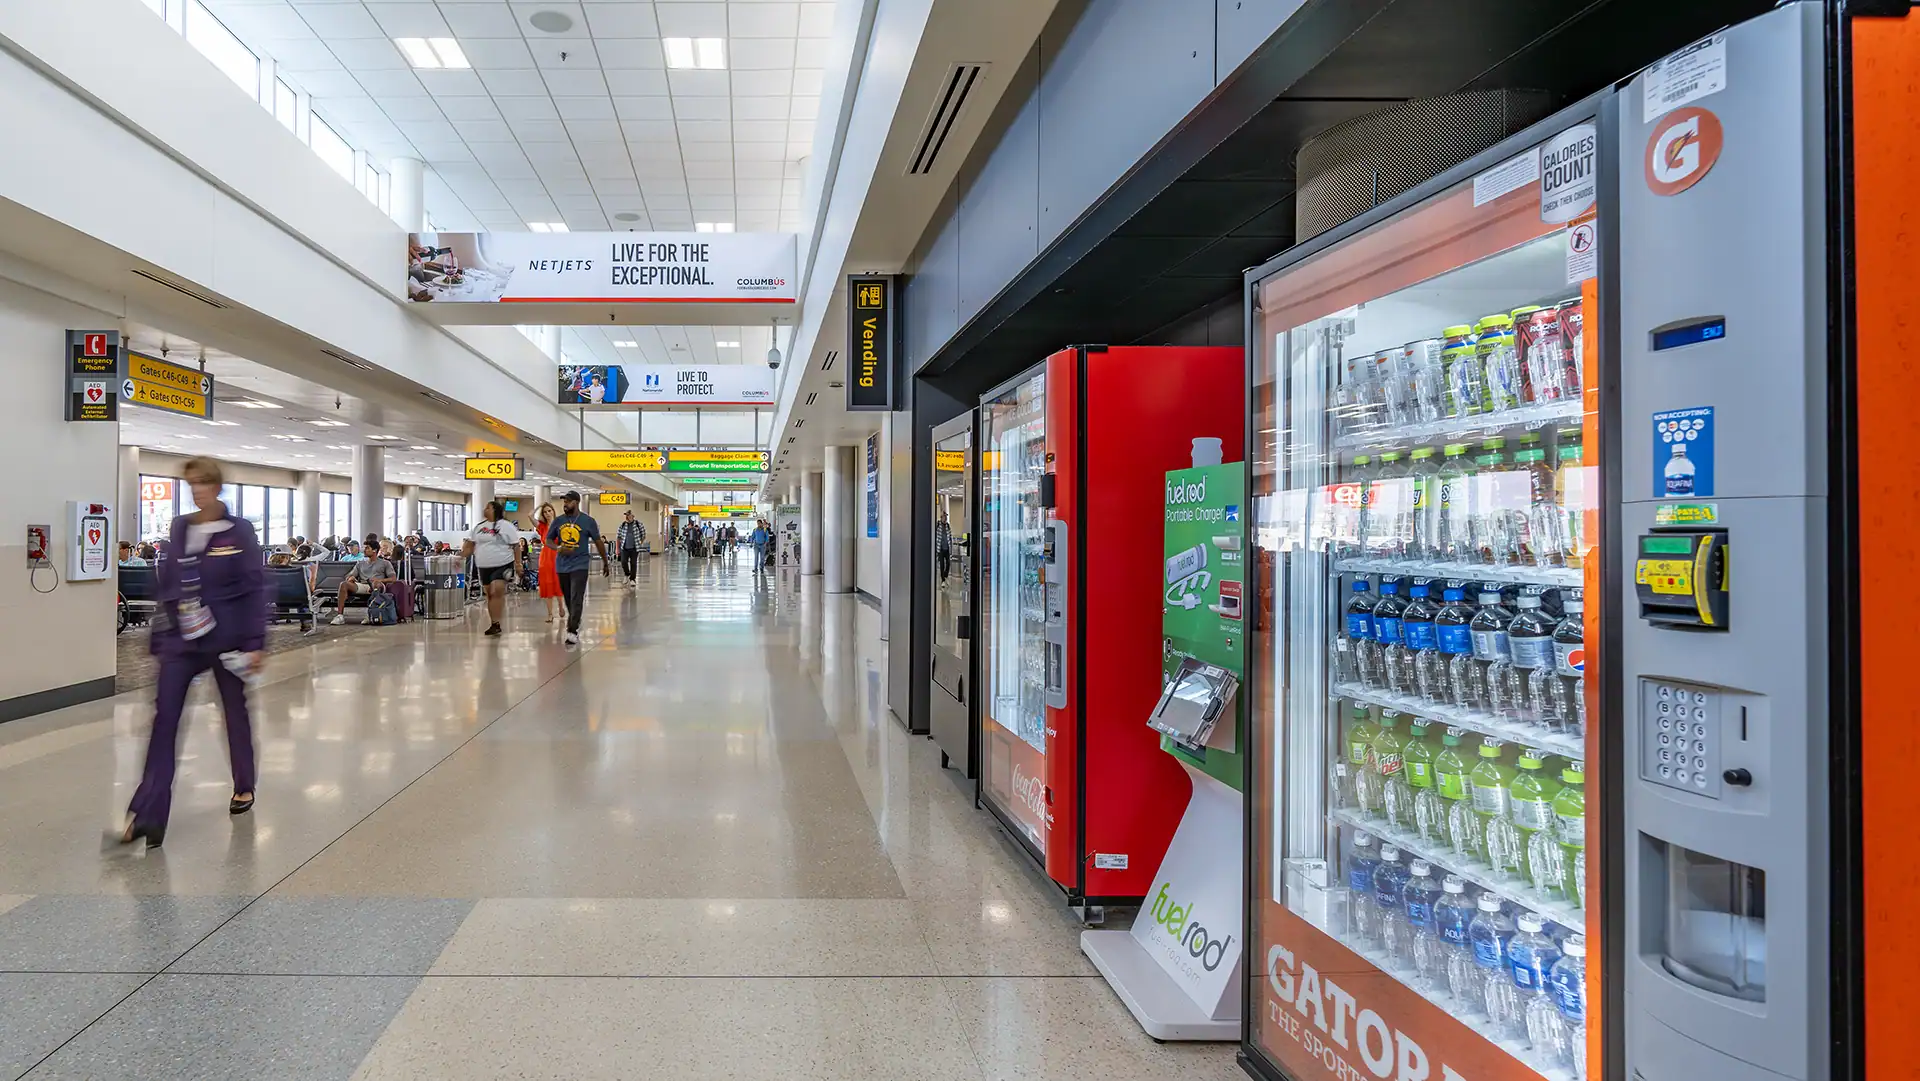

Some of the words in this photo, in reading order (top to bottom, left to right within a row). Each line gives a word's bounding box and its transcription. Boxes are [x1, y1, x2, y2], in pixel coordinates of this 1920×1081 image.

[1543, 136, 1594, 171] CALORIES
[1544, 153, 1594, 192] COUNT
[1543, 200, 1559, 213] CHECK
[1560, 195, 1573, 206] THEN
[1574, 186, 1594, 202] CHOOSE
[612, 243, 644, 262] LIVE
[649, 243, 677, 262] FOR
[680, 243, 709, 262] THE
[529, 260, 592, 274] NETJETS
[612, 266, 714, 286] EXCEPTIONAL.
[77, 357, 114, 366] Emergency
[859, 317, 877, 387] Vending
[140, 364, 161, 378] Gates
[162, 370, 189, 385] C46-C49
[677, 371, 696, 382] LIVE
[697, 371, 708, 382] TO
[149, 390, 170, 403] Gates
[171, 393, 196, 409] C51-C56
[677, 384, 714, 395] PROTECT.
[469, 467, 485, 475] Gate
[487, 463, 512, 475] C50
[1166, 508, 1193, 522] Portable
[1195, 507, 1224, 524] Charger
[1150, 882, 1231, 972] fuelrod
[1268, 944, 1468, 1081] GATOR
[1269, 1000, 1300, 1042] THE
[1303, 1029, 1369, 1081] SPORT
